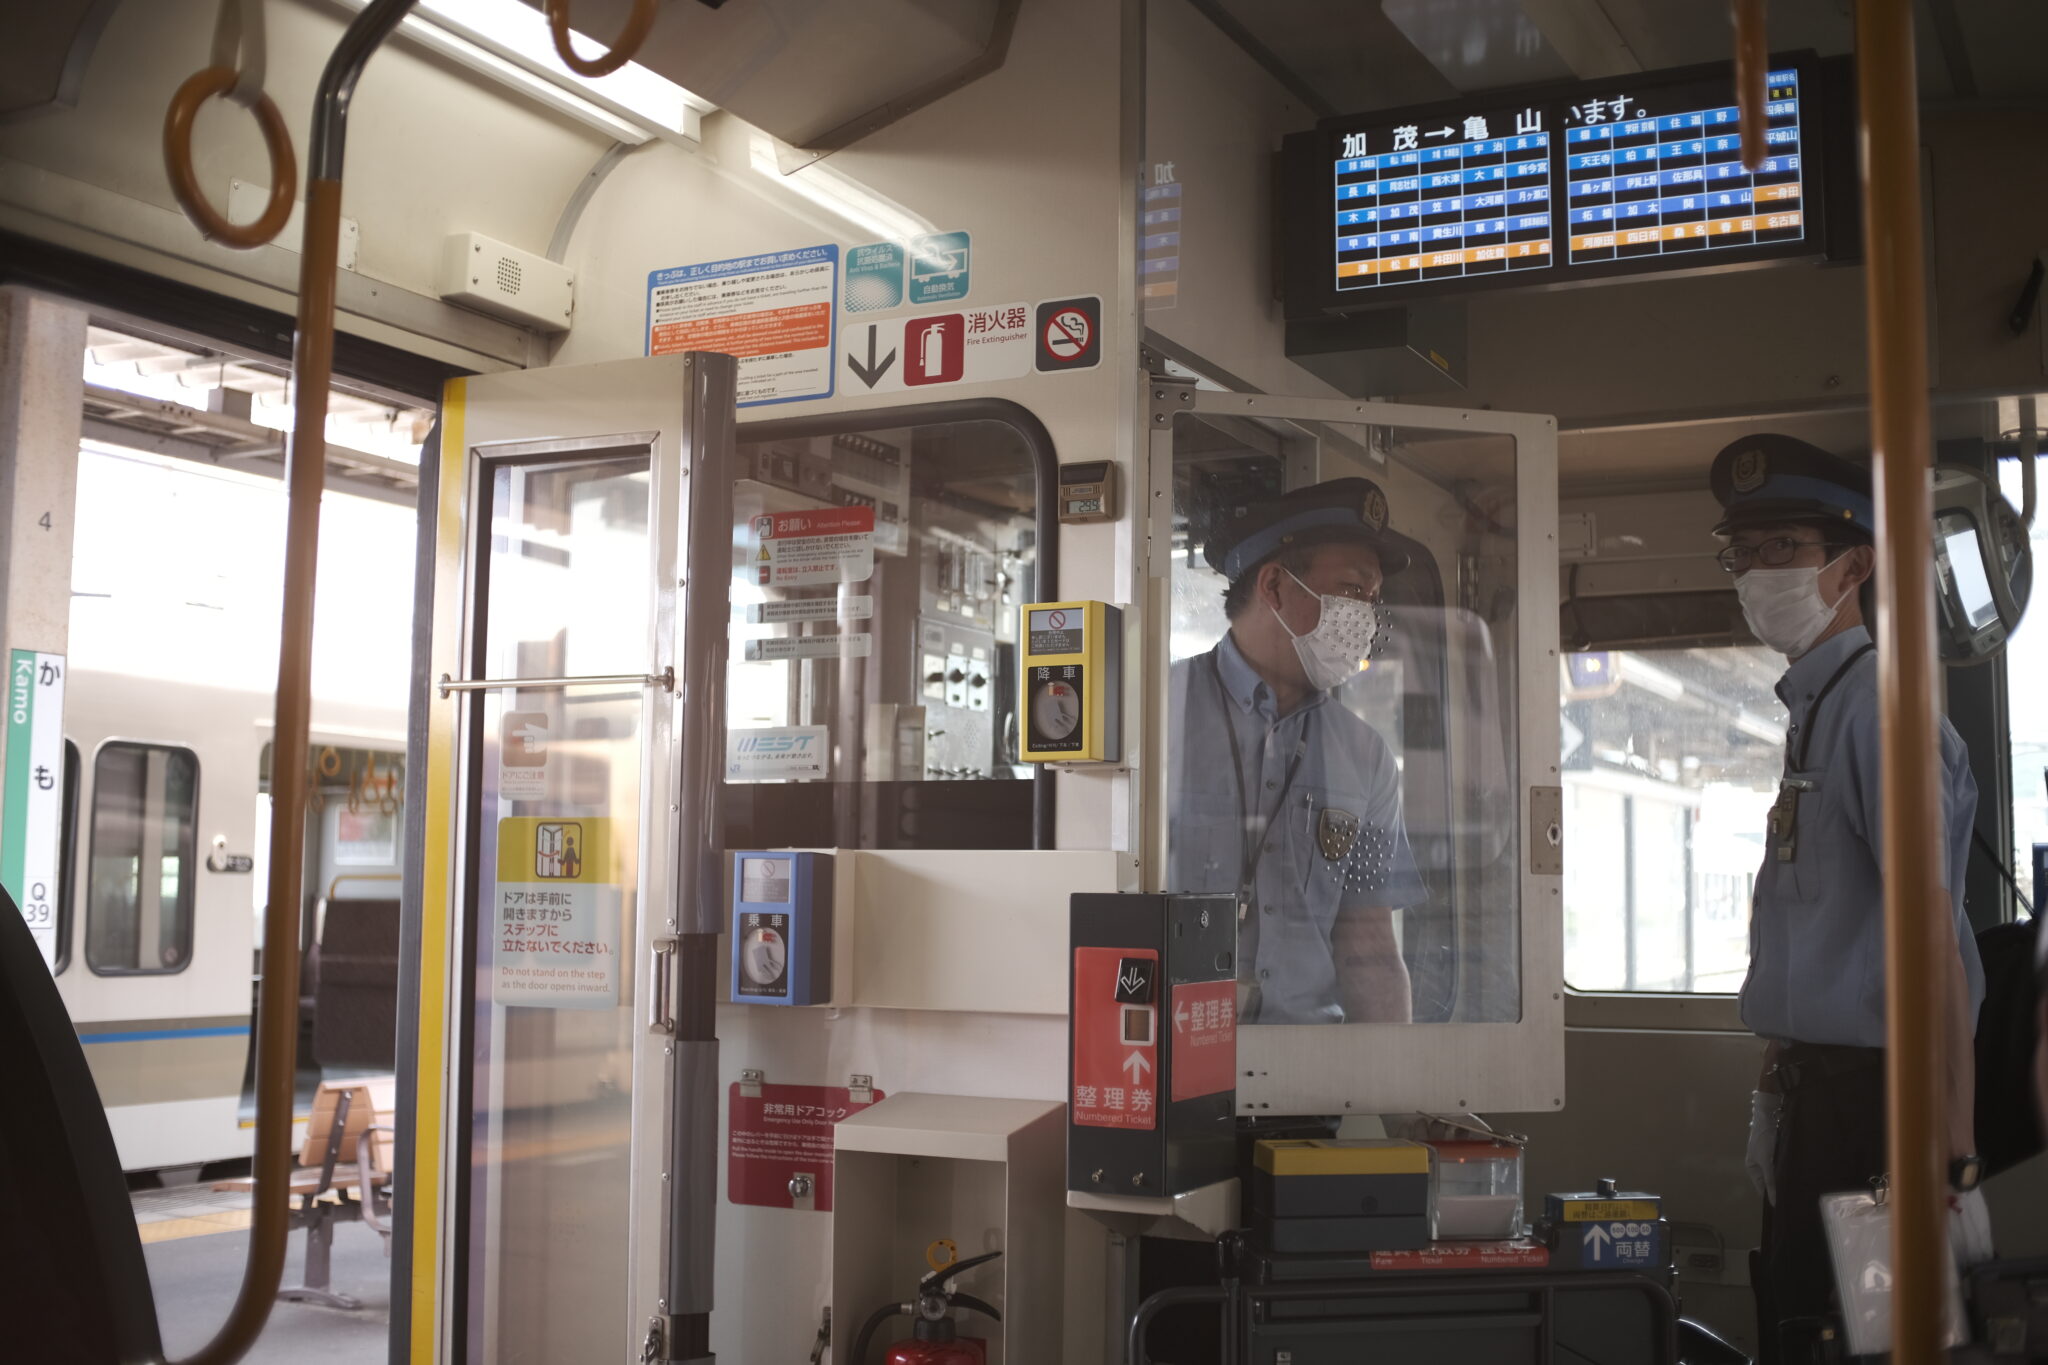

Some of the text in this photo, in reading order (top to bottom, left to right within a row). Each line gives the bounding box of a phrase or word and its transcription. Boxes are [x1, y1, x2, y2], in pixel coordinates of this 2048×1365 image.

[1581, 155, 1611, 168] 天王寺
[967, 307, 1026, 334] 消火器
[966, 332, 1027, 346] Fire Extinguisher
[37, 511, 53, 532] 4
[777, 518, 812, 533] お願い
[1037, 666, 1077, 682] 降車
[12, 658, 33, 725] Kamo
[503, 892, 573, 906] ドアは手前に
[25, 903, 50, 923] 39
[503, 908, 573, 922] 開きますから
[503, 923, 559, 937] ステップに
[502, 967, 513, 976] Do
[516, 968, 530, 976] not
[532, 968, 555, 977] stand
[571, 968, 585, 978] the
[587, 970, 606, 980] step
[512, 980, 526, 989] the
[528, 981, 548, 990] door
[550, 983, 576, 993] opens
[577, 983, 610, 993] inward.
[1191, 998, 1234, 1032] 整理券
[1076, 1085, 1153, 1112] 整理券
[763, 1103, 847, 1118] 非常用ドアコック
[1076, 1111, 1152, 1125] Numbered Ticket
[1616, 1241, 1651, 1257] 両替
[1421, 1257, 1443, 1265] Ticket
[1481, 1256, 1519, 1264] Numbered
